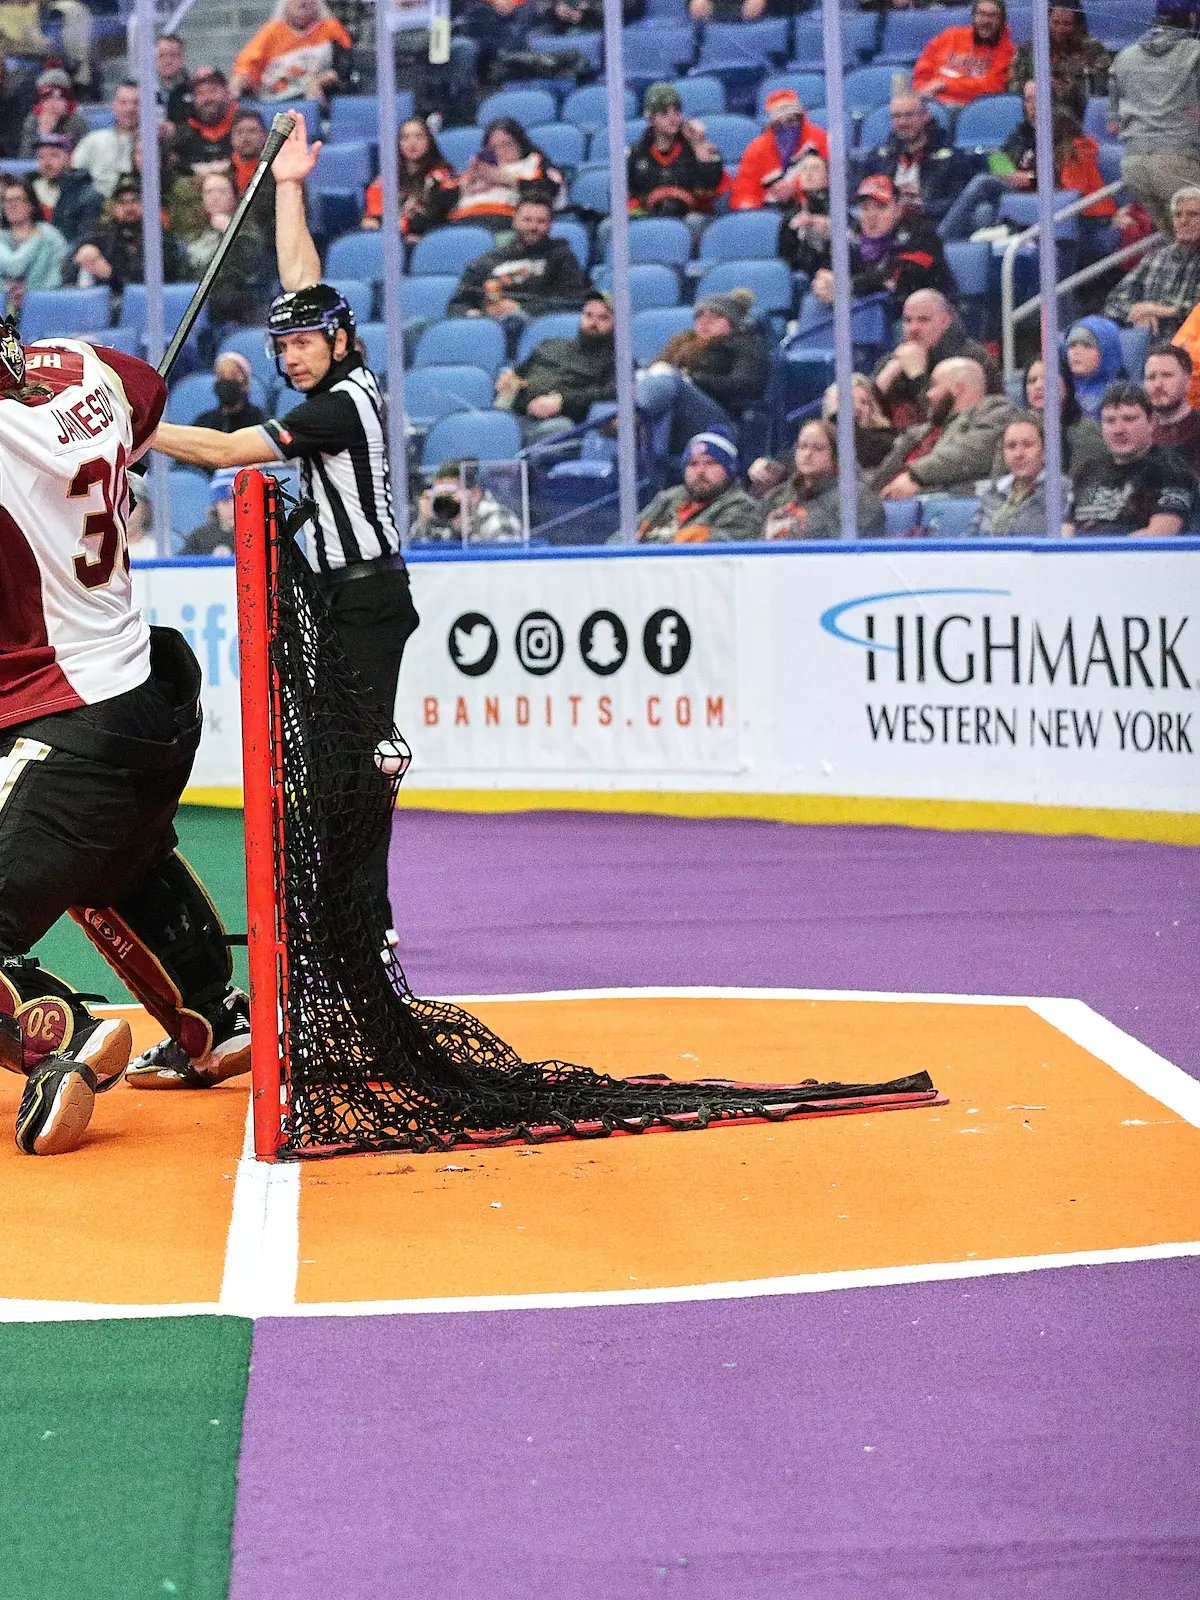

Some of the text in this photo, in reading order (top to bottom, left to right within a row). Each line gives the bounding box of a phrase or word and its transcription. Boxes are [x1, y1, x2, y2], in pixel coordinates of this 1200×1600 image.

[865, 614, 1192, 689] HIGHMARK
[422, 694, 727, 729] BANDITS.COM
[865, 703, 1194, 755] WESTERN NEW YORK
[27, 1006, 61, 1042] 30
